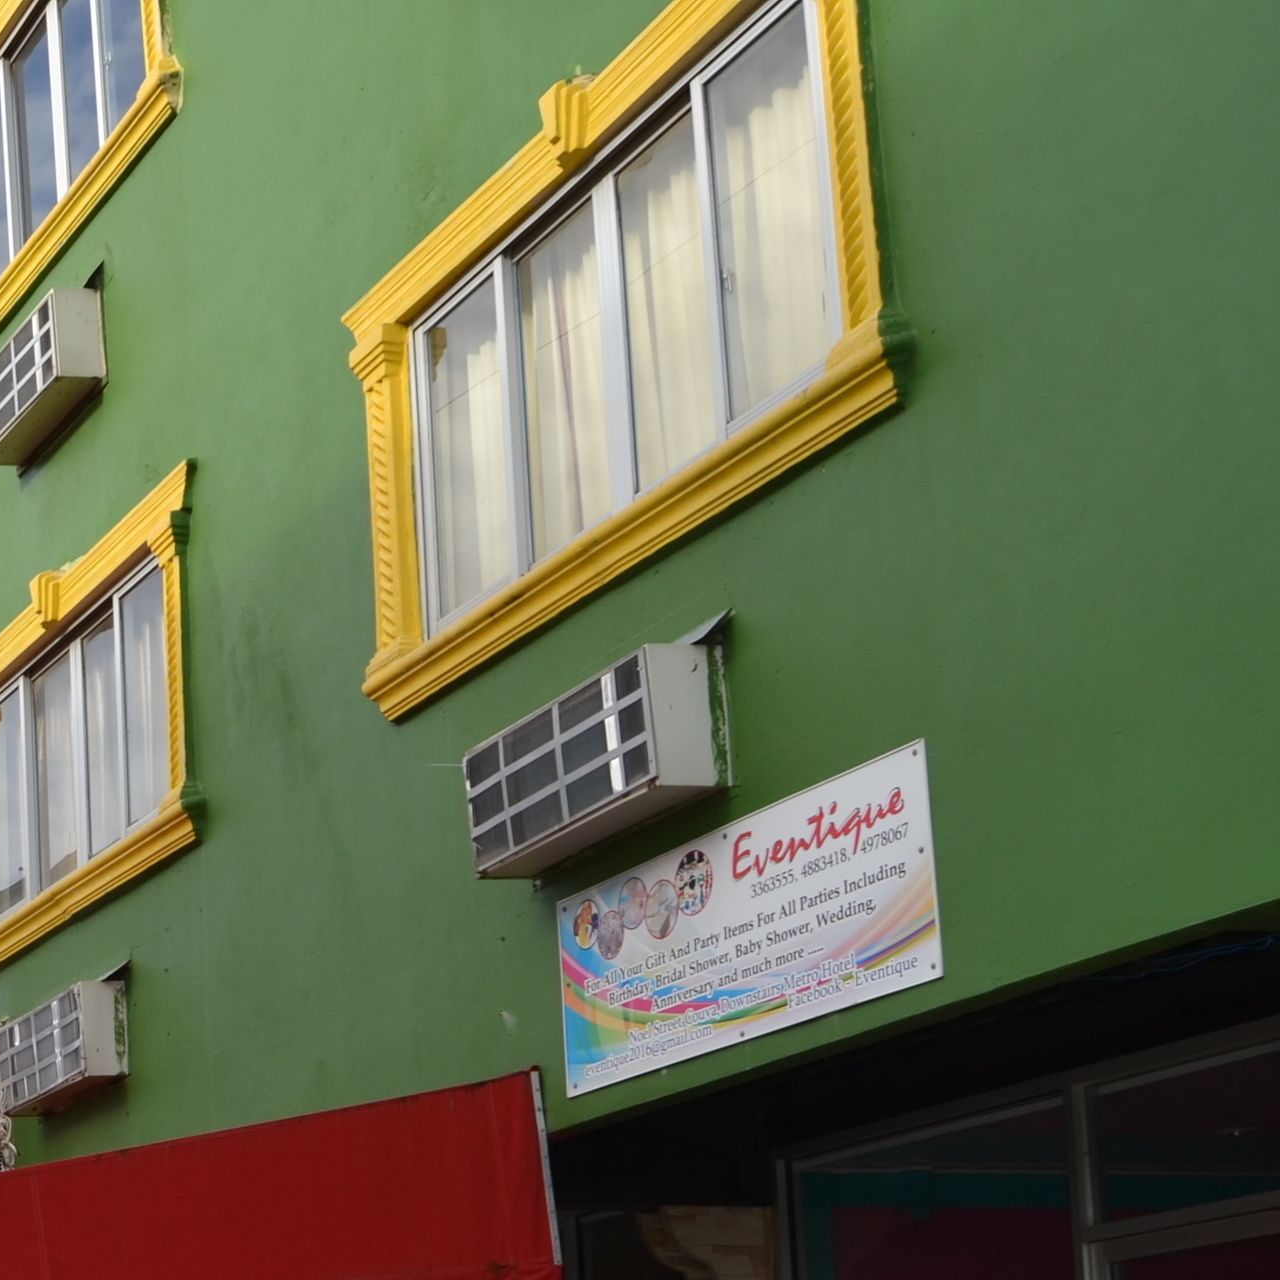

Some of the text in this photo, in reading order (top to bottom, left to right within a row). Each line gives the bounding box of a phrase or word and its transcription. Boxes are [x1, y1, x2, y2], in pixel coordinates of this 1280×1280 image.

[732, 786, 905, 880] Eventique
[750, 822, 909, 899] 3363555, 4883418, 4978067
[586, 861, 907, 994] For All Your Gift And Party Items For All Parties Including
[655, 964, 687, 988] Bridal
[689, 951, 733, 976] Shower,
[735, 937, 763, 959] Baby
[766, 919, 814, 948] Shower,
[816, 898, 877, 928] Wedding,
[629, 1022, 652, 1043] Noel
[653, 1015, 681, 1036] Street
[720, 984, 781, 1014] Downstairs
[784, 970, 819, 992] Metro
[821, 953, 855, 978] Hotel
[651, 978, 715, 1011] Anniversary
[717, 970, 738, 987] and
[741, 956, 772, 979] much
[775, 947, 805, 969] more
[788, 978, 842, 1008] Facebook
[855, 956, 918, 987] Eventique
[585, 1023, 712, 1077] eventique2016@gmail.com
